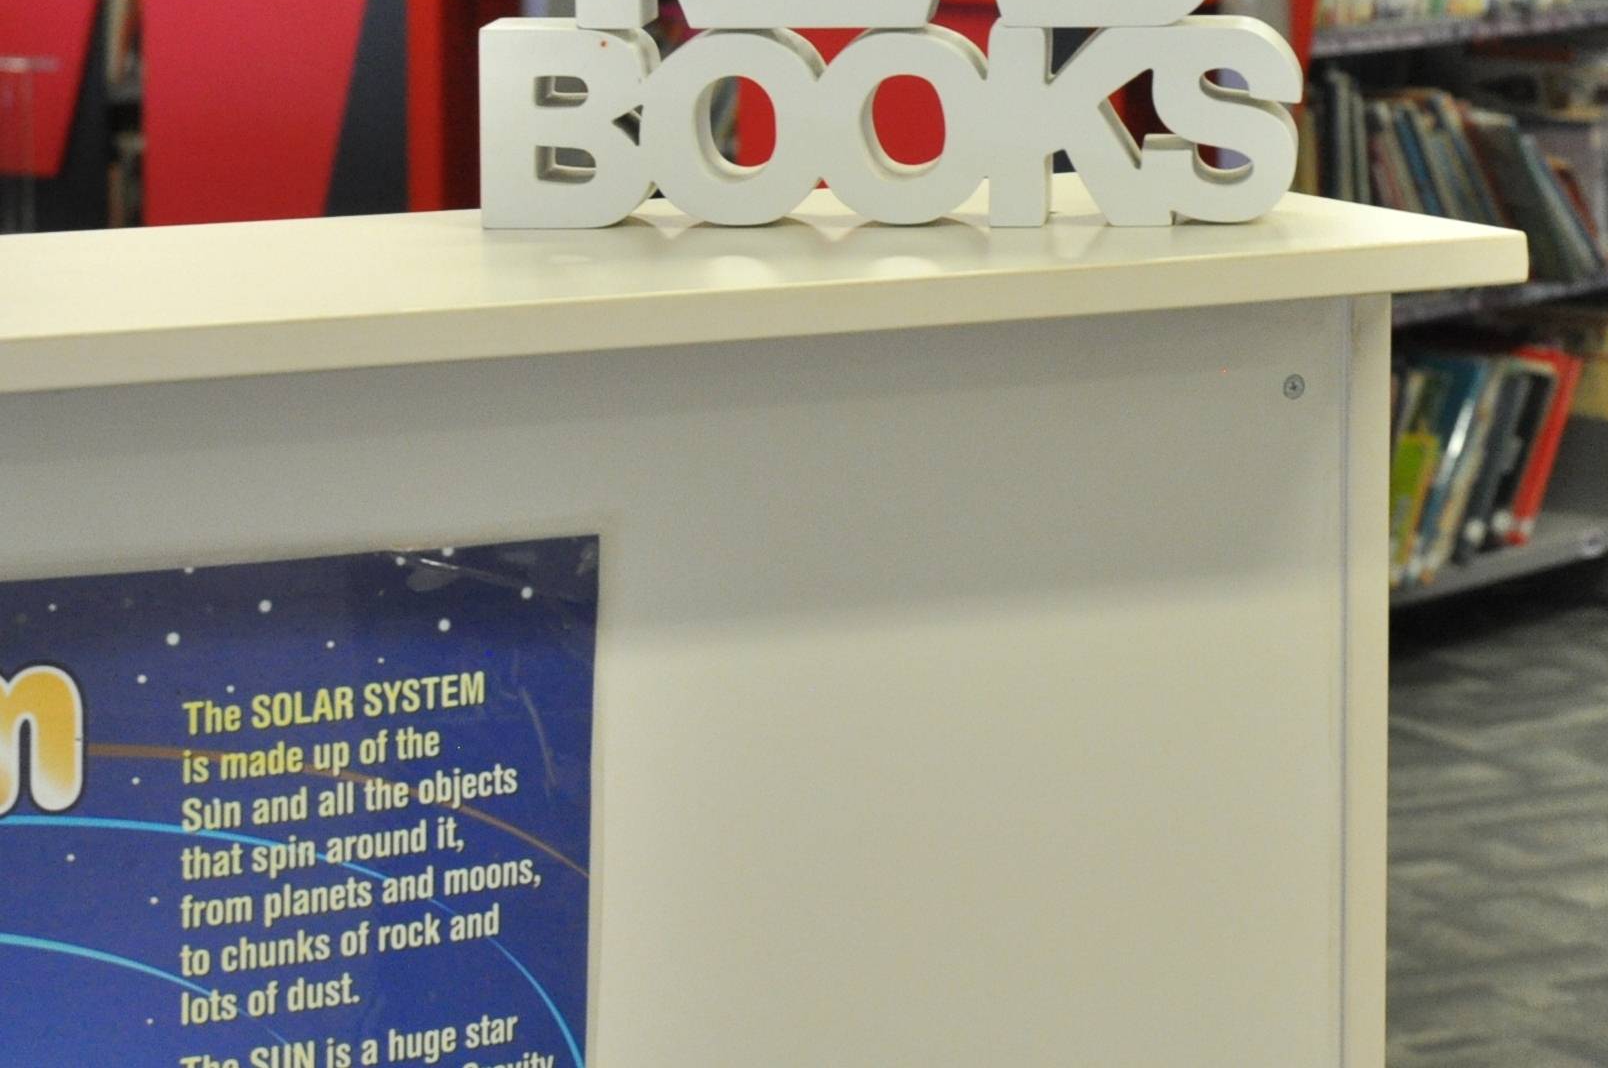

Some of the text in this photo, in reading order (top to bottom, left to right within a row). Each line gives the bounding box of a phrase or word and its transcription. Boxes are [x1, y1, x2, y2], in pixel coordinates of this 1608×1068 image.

[480, 15, 1304, 229] BOOKS
[182, 671, 485, 735] The SOLAR SYSTEM
[182, 726, 440, 784] is made up of the
[182, 763, 518, 831] Sun and all the objects
[181, 816, 465, 880] that spin around it,
[181, 858, 542, 929] from planets and moons,
[180, 902, 500, 977] to chunks of rock and
[181, 971, 361, 1026] lots of dust.
[250, 1040, 315, 1068] SUN
[326, 1037, 351, 1068] is
[361, 1039, 379, 1065] a
[388, 1028, 457, 1063] huge
[465, 1014, 519, 1049] star
